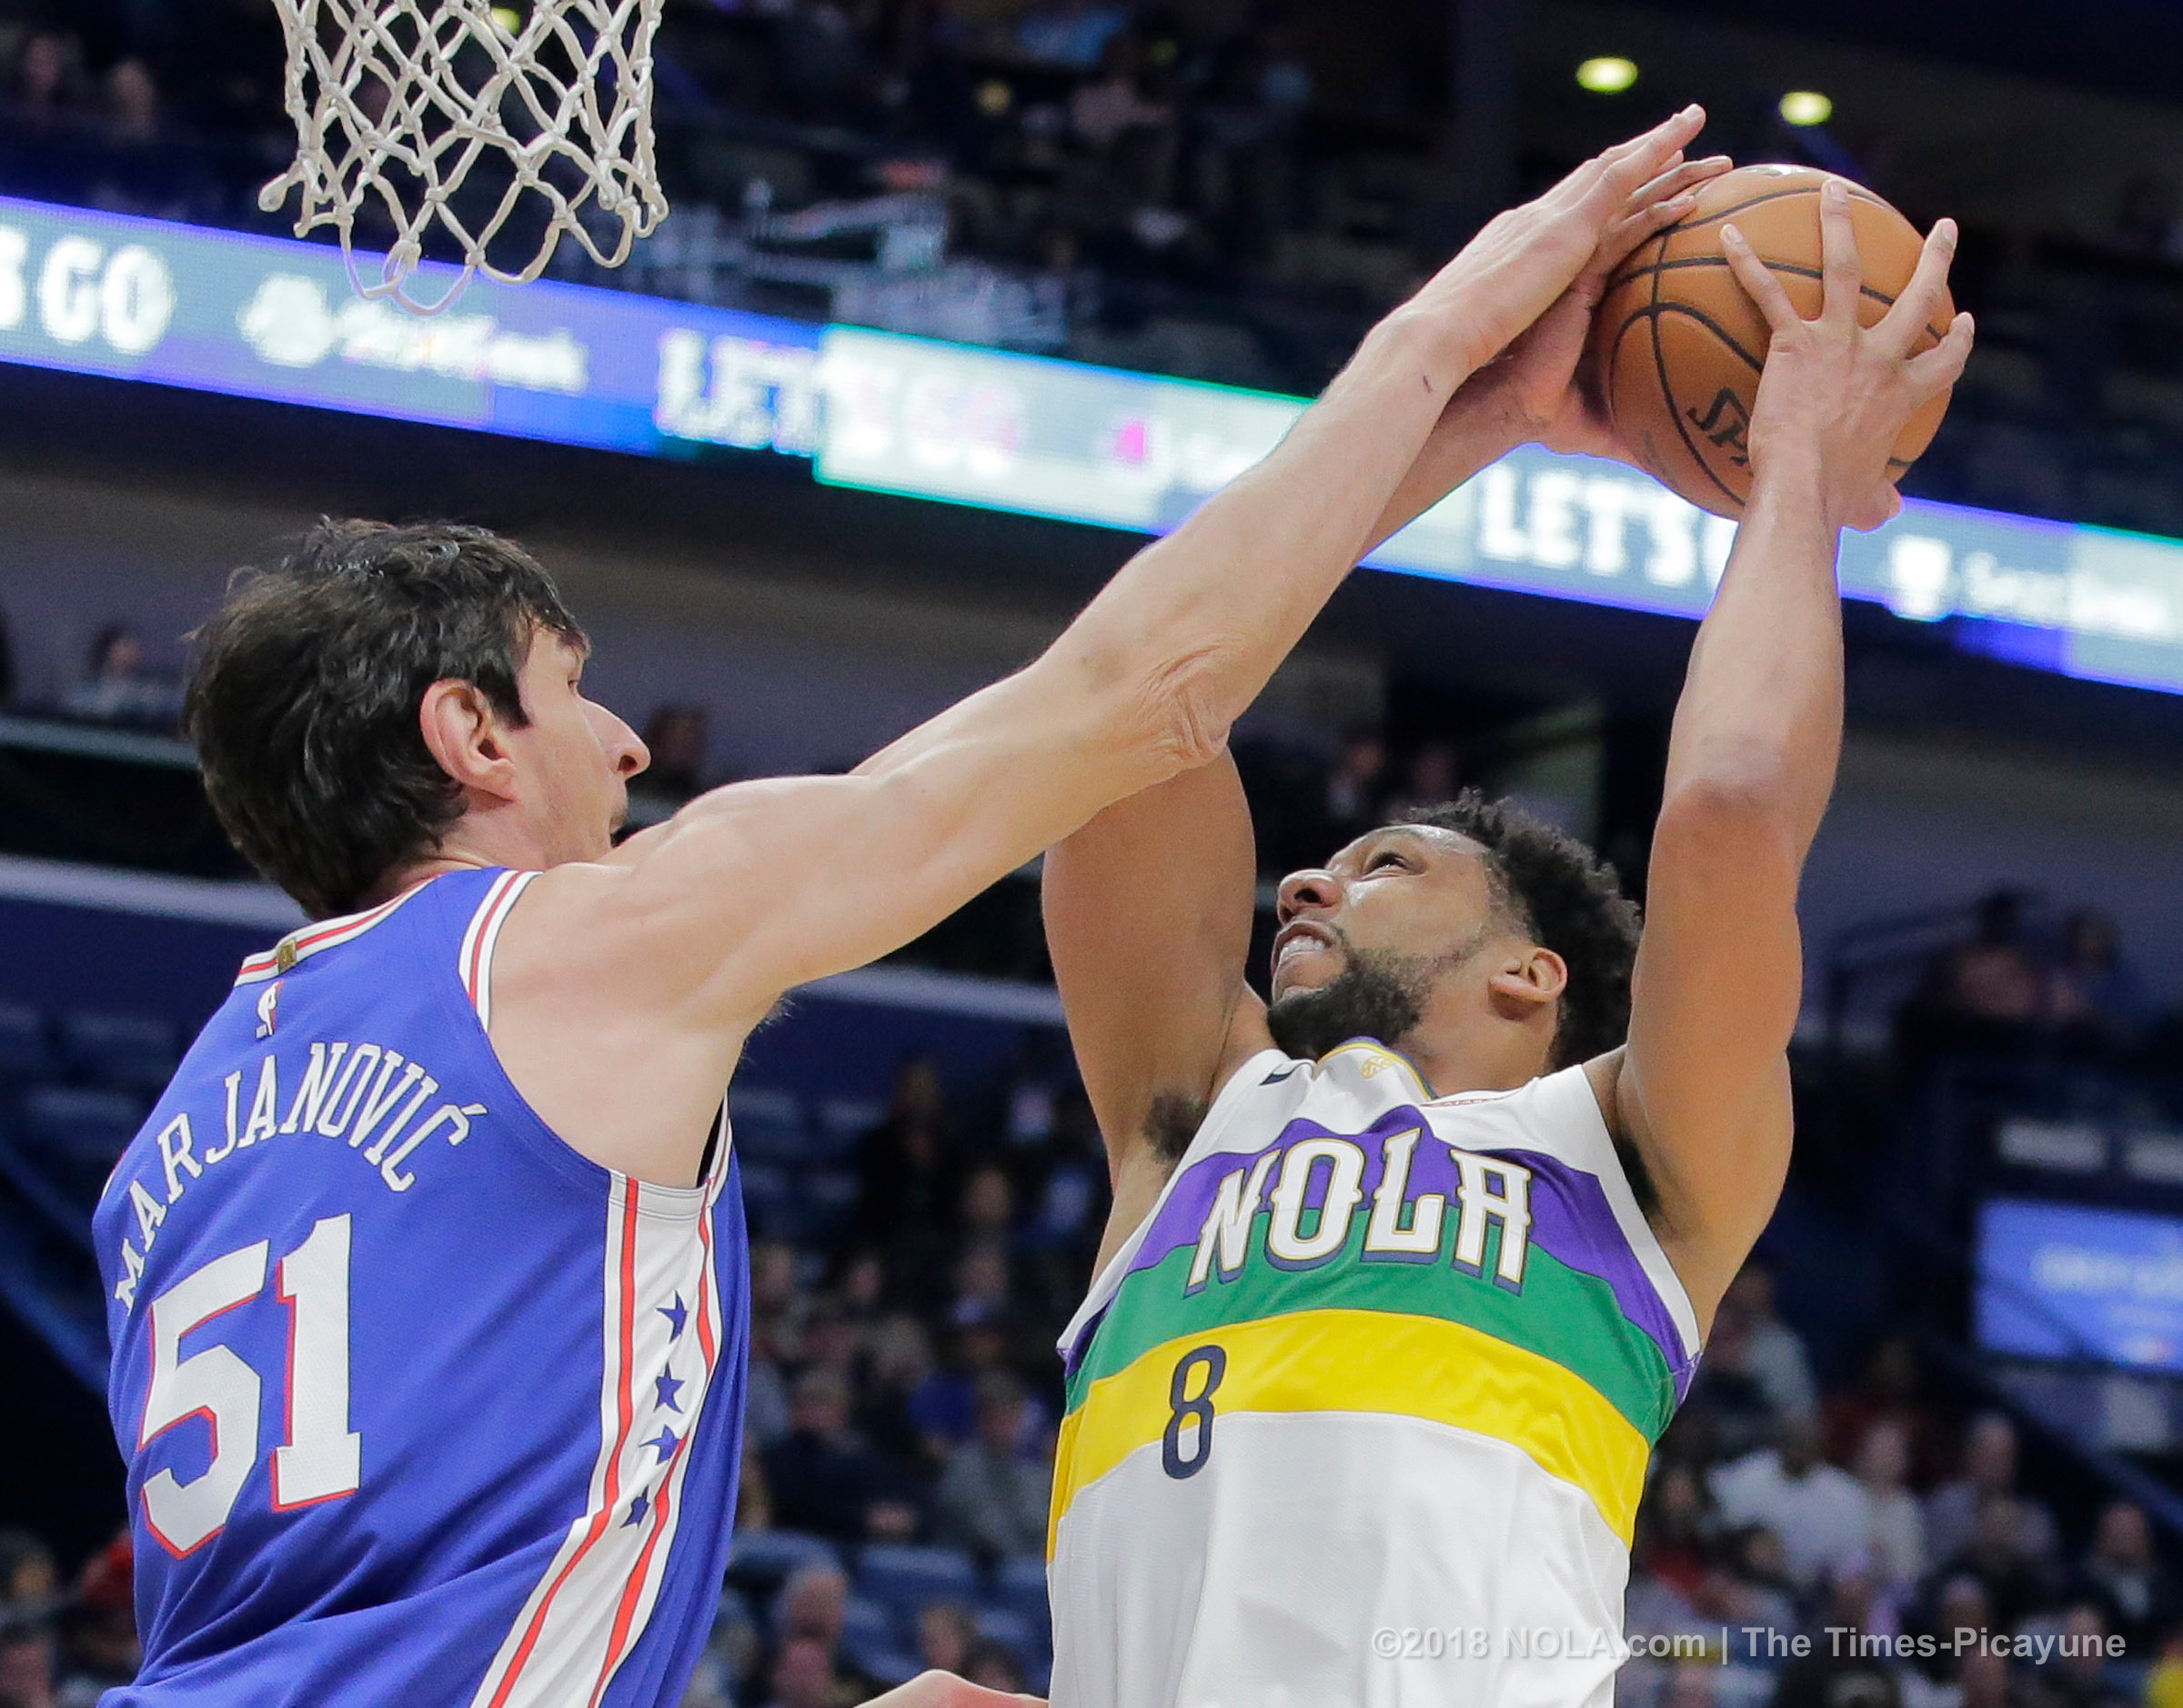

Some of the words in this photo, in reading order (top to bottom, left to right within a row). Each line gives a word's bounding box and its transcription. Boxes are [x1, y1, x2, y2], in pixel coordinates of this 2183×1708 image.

[39, 234, 175, 356] GO
[115, 1042, 488, 1316] MARJANOVIĆ
[1184, 1127, 1532, 1296] NOLA
[137, 1212, 361, 1560] 51
[1162, 1344, 1226, 1479] 8
